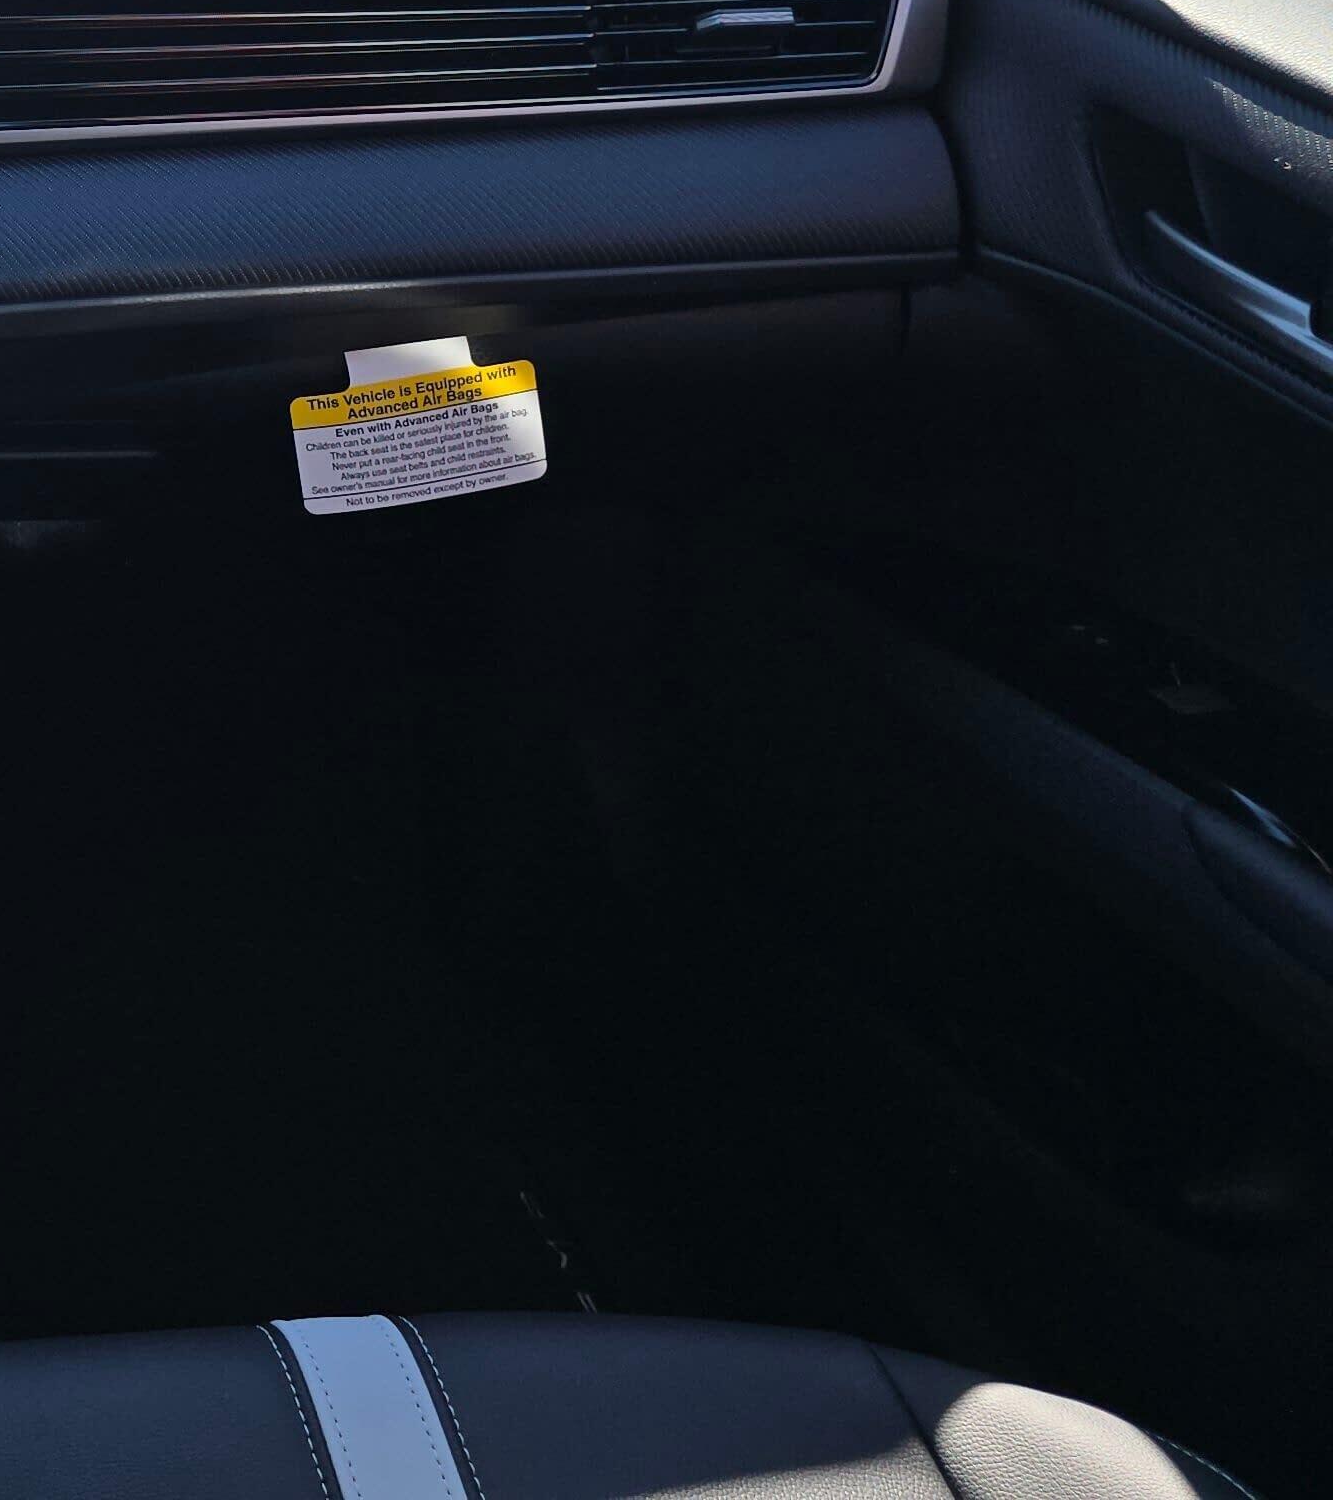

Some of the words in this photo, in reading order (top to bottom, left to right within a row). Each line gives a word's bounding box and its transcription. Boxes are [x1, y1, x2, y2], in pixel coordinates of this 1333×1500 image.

[306, 397, 340, 411] This
[343, 388, 395, 406] Vehicle
[399, 385, 412, 397] is
[416, 372, 483, 394] Equipped
[487, 365, 517, 381] with
[348, 397, 419, 420] Advanced
[422, 393, 442, 407] Air
[446, 387, 482, 402] Bags
[306, 441, 342, 452] Children
[343, 439, 359, 448] can
[360, 437, 372, 446] be
[373, 434, 395, 444] killed
[407, 424, 443, 438] seriously
[444, 419, 472, 432] injured
[473, 415, 483, 425] by
[484, 413, 498, 422] the
[499, 411, 510, 420] air
[511, 408, 528, 417] bag.
[335, 426, 365, 438] Even
[367, 421, 391, 432] with
[394, 411, 449, 429] Advanced
[452, 407, 468, 418] Air
[471, 402, 499, 414] Bags
[330, 451, 347, 460] The
[348, 448, 369, 458] back
[371, 446, 389, 455] seat
[390, 443, 398, 452] is
[399, 441, 413, 450] the
[414, 437, 438, 448] safest
[440, 432, 462, 444] place
[463, 428, 473, 437] for
[475, 423, 509, 435] children.
[332, 462, 357, 471] Never
[359, 459, 372, 469] put
[374, 458, 381, 466] a
[382, 451, 425, 465] rear-facing
[427, 445, 446, 457] child
[447, 442, 465, 453] seat
[466, 440, 475, 448] in
[476, 437, 489, 446] the
[490, 433, 511, 444] front.
[311, 486, 329, 495] See
[330, 482, 363, 493] owner's
[364, 477, 395, 489] manual
[397, 475, 408, 484] for
[410, 471, 431, 482] more
[432, 463, 477, 478] information
[478, 458, 501, 469] about
[502, 455, 514, 465] air
[514, 452, 537, 463] bags.
[341, 471, 370, 481] Always
[371, 468, 388, 476] use
[389, 465, 407, 474] seat
[408, 460, 429, 471] belts
[430, 457, 446, 467] and
[447, 452, 467, 464] child
[467, 447, 507, 460] restraints.
[346, 497, 364, 507] Not
[365, 495, 375, 504] to
[376, 493, 390, 502] be
[391, 487, 431, 501] removed
[434, 481, 464, 493] except
[465, 478, 477, 488] by
[478, 474, 509, 485] owner.
